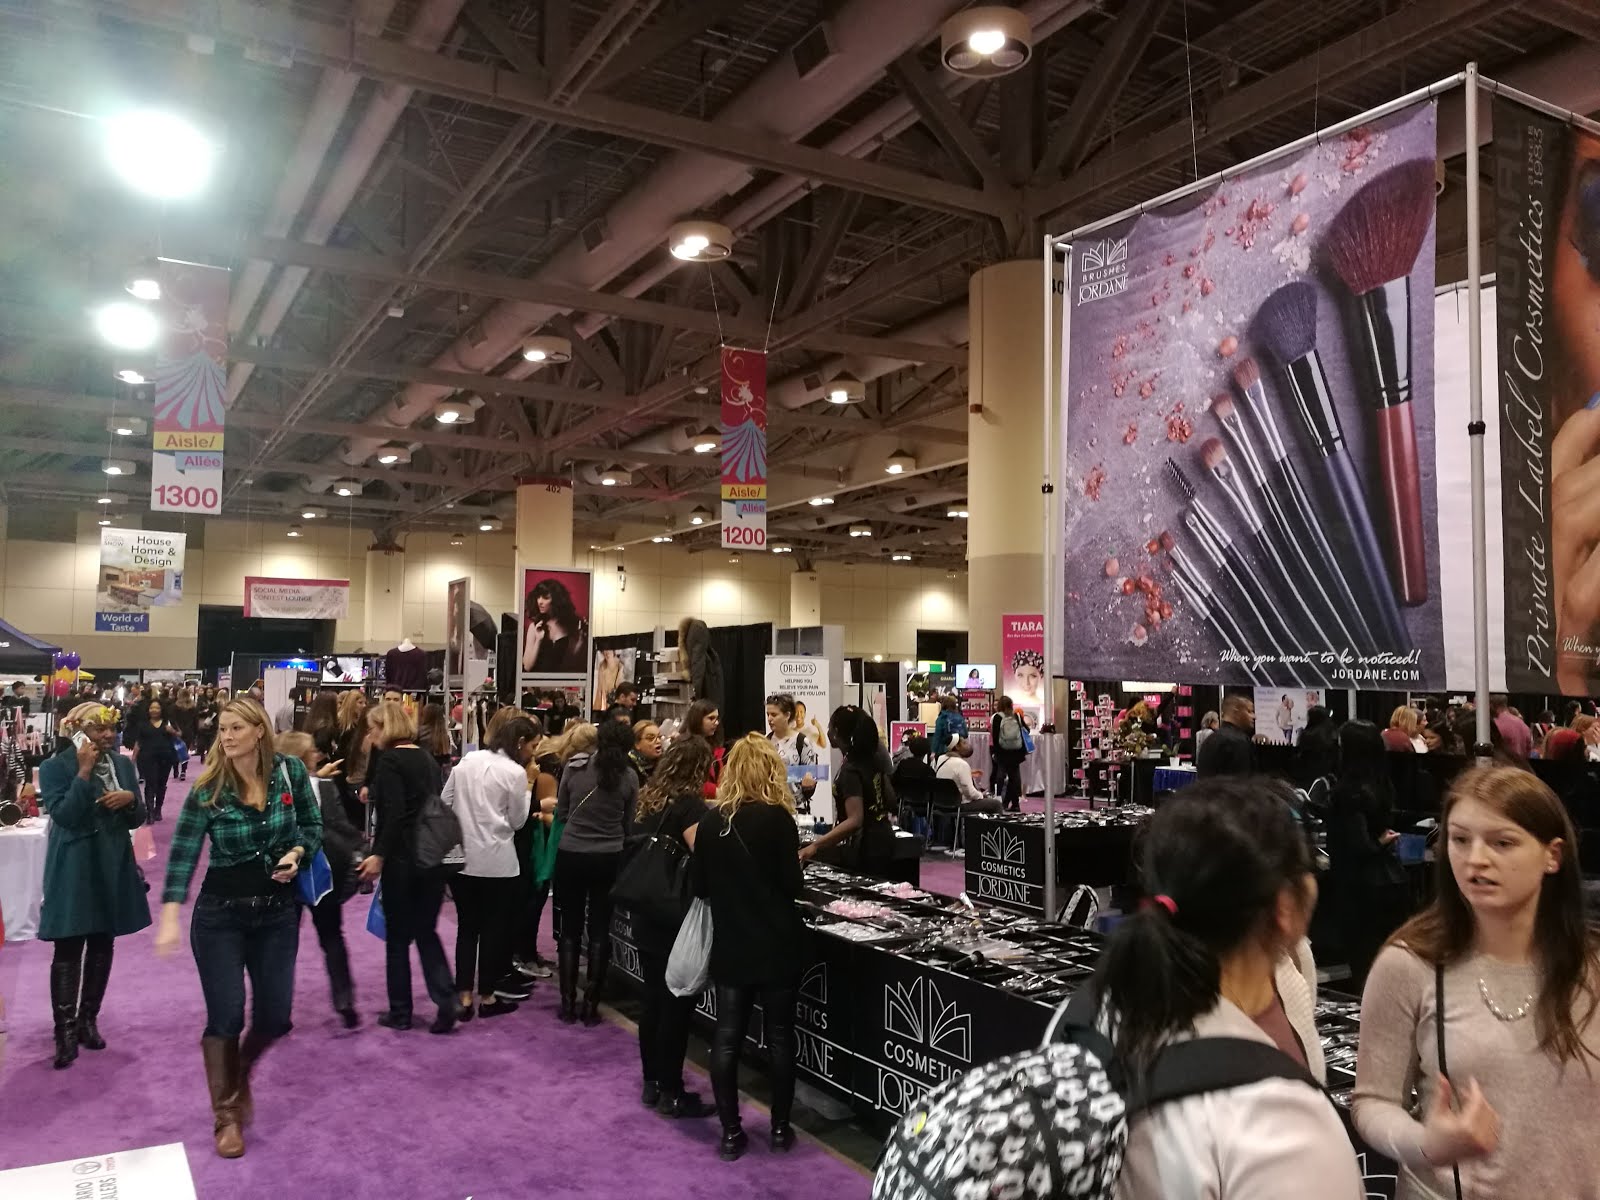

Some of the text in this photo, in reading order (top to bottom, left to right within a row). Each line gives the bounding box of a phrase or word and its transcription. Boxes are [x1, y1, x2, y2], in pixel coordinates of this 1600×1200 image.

[1534, 128, 1544, 186] 1983
[1082, 262, 1127, 284] BRUSHES
[1077, 274, 1129, 307] JORDANE
[165, 433, 216, 449] Aisle/
[1505, 194, 1551, 679] Private Label Cosmetics
[184, 455, 222, 468] Allée
[154, 484, 218, 509] 1300
[729, 487, 761, 498] Aisle/
[741, 503, 765, 513] Allée
[137, 535, 172, 547] House
[723, 526, 765, 546] 1200
[131, 545, 176, 556] Home &
[134, 555, 172, 568] Design
[253, 587, 277, 595] SOCIAL
[253, 594, 313, 603] CONTEST LOUNGE
[102, 614, 144, 623] World of
[1011, 621, 1044, 632] TIARA
[110, 623, 135, 632] Taste
[1562, 635, 1593, 654] When
[1220, 647, 1422, 672] When you want to be noticed!
[1331, 669, 1420, 681] JORDANE.COM
[981, 861, 1026, 879] COSMETICS
[977, 876, 1032, 905] JORDANE
[796, 1001, 828, 1030] ETICS
[75, 1181, 94, 1200] ARIO
[99, 1177, 118, 1200] ALERS
